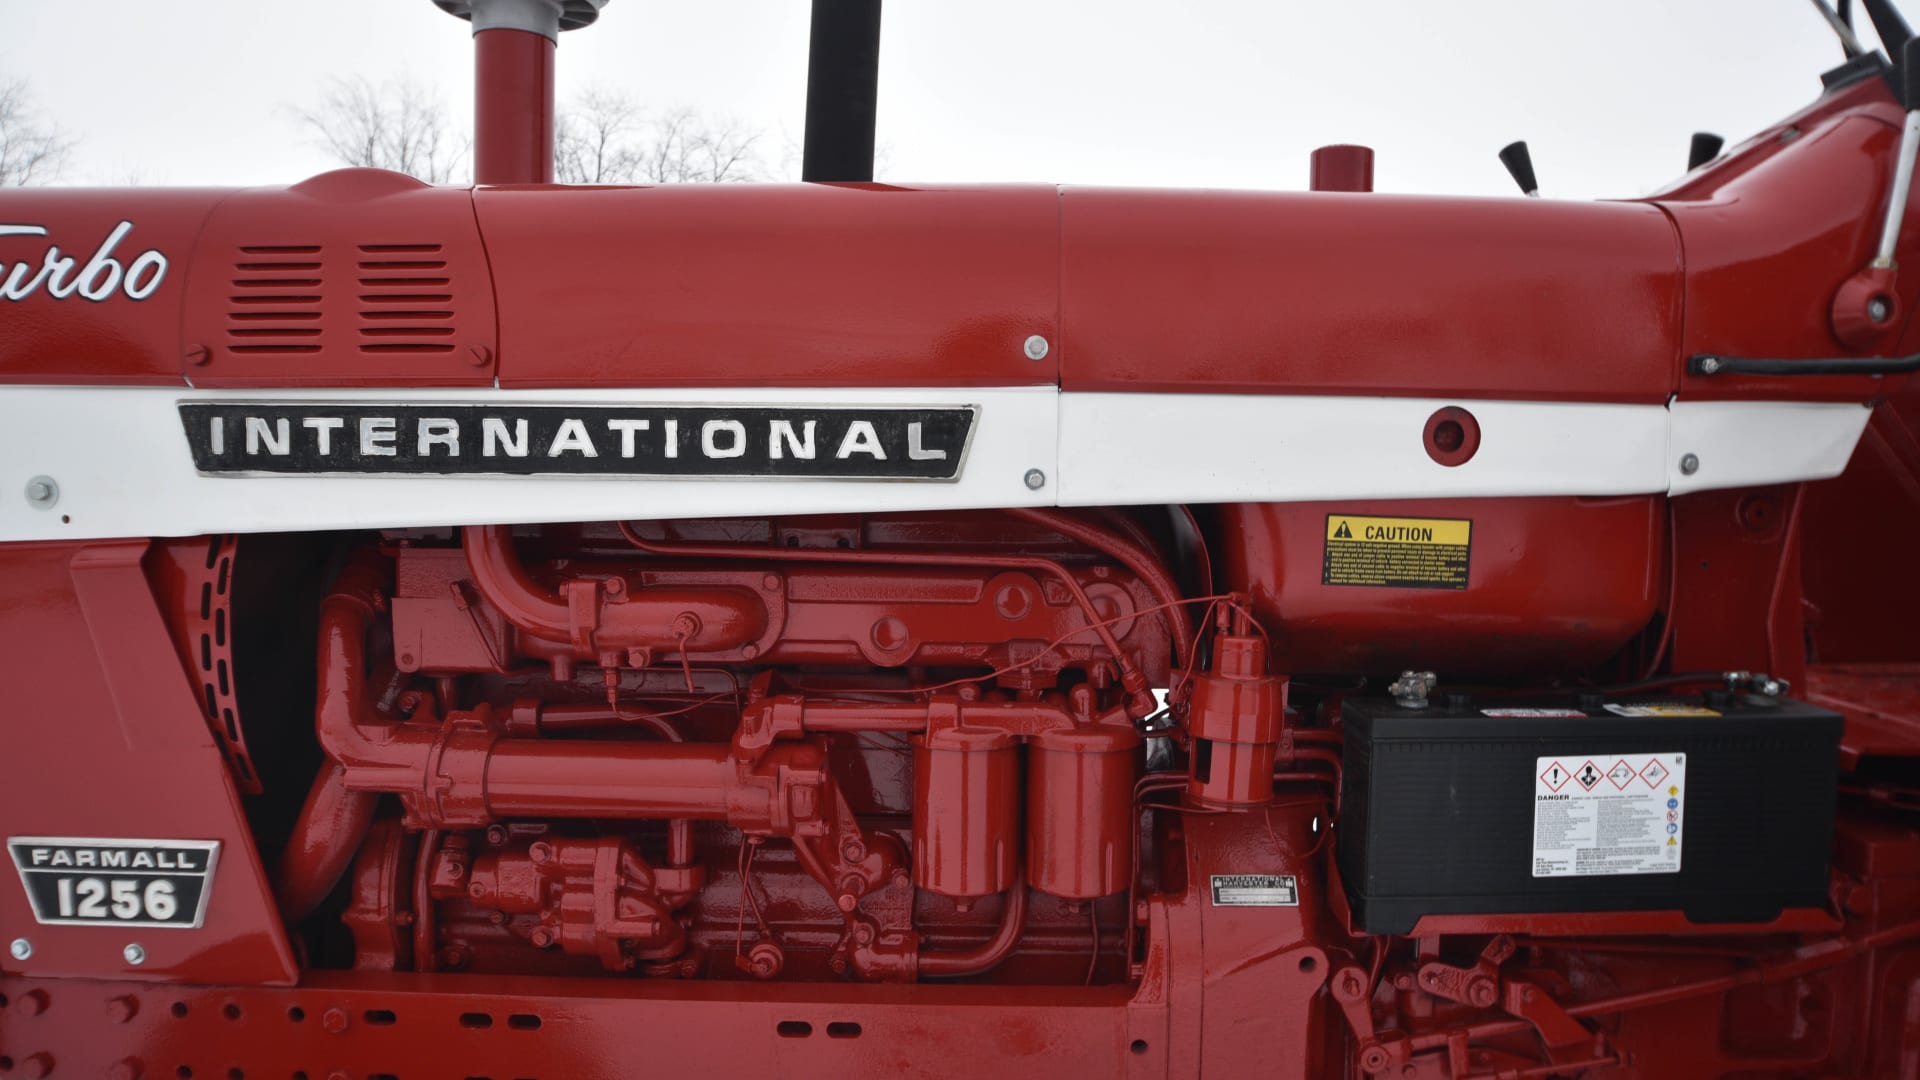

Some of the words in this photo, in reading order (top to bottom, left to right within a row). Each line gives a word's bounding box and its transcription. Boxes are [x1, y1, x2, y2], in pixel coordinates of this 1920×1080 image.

[210, 415, 948, 462] INTERNATIONAL
[1365, 525, 1433, 541] CAUTION
[32, 848, 197, 869] FARMALL
[57, 877, 178, 920] 1256
